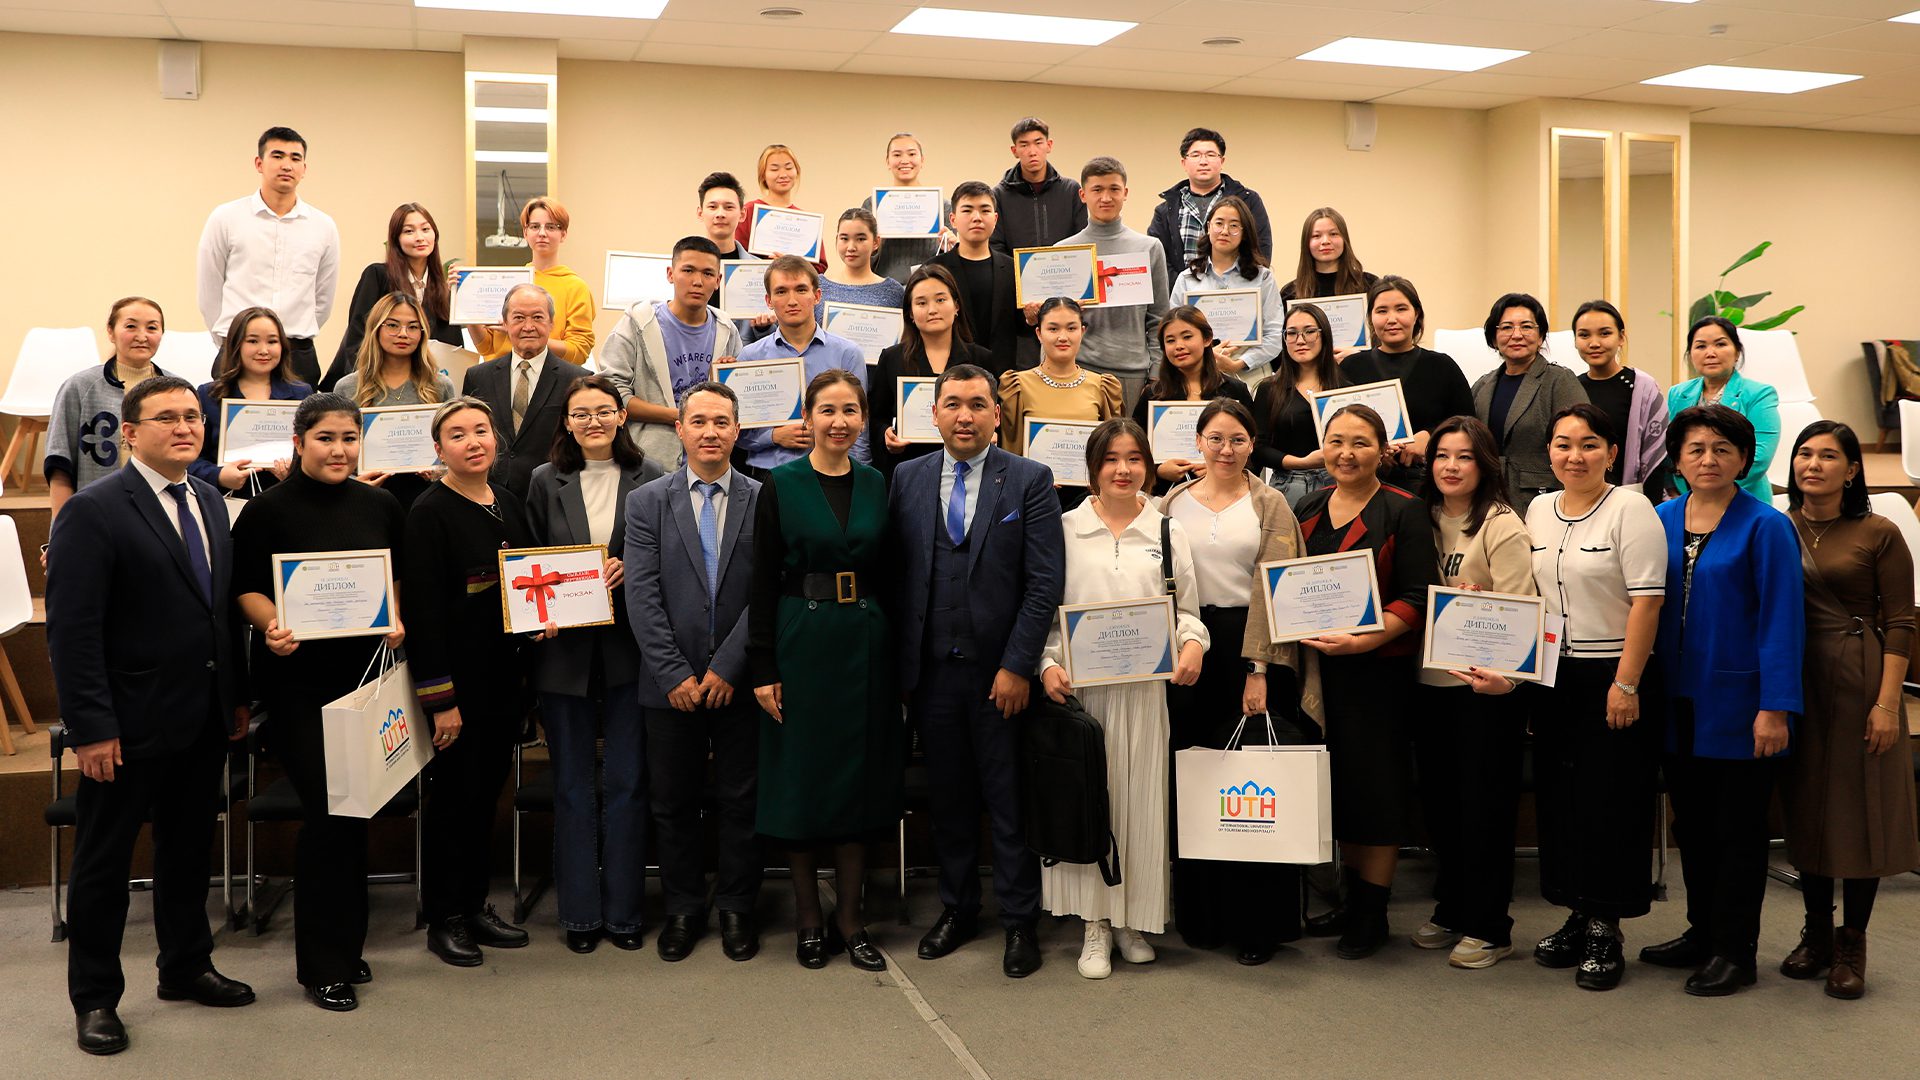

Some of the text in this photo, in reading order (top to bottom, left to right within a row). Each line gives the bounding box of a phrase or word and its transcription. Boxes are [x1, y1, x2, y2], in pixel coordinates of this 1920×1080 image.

[673, 353, 687, 367] WE
[688, 352, 704, 362] ARE
[743, 383, 777, 393] ДИПЛОМ
[251, 423, 288, 431] ДИПЛОМ
[387, 428, 423, 438] ДИПЛОМ
[313, 581, 356, 592] ДИПЛОМ
[1299, 582, 1341, 595] ДИПЛОМ
[1463, 620, 1507, 631] ДИПЛОМ
[1098, 628, 1139, 640] ДИПЛОМ
